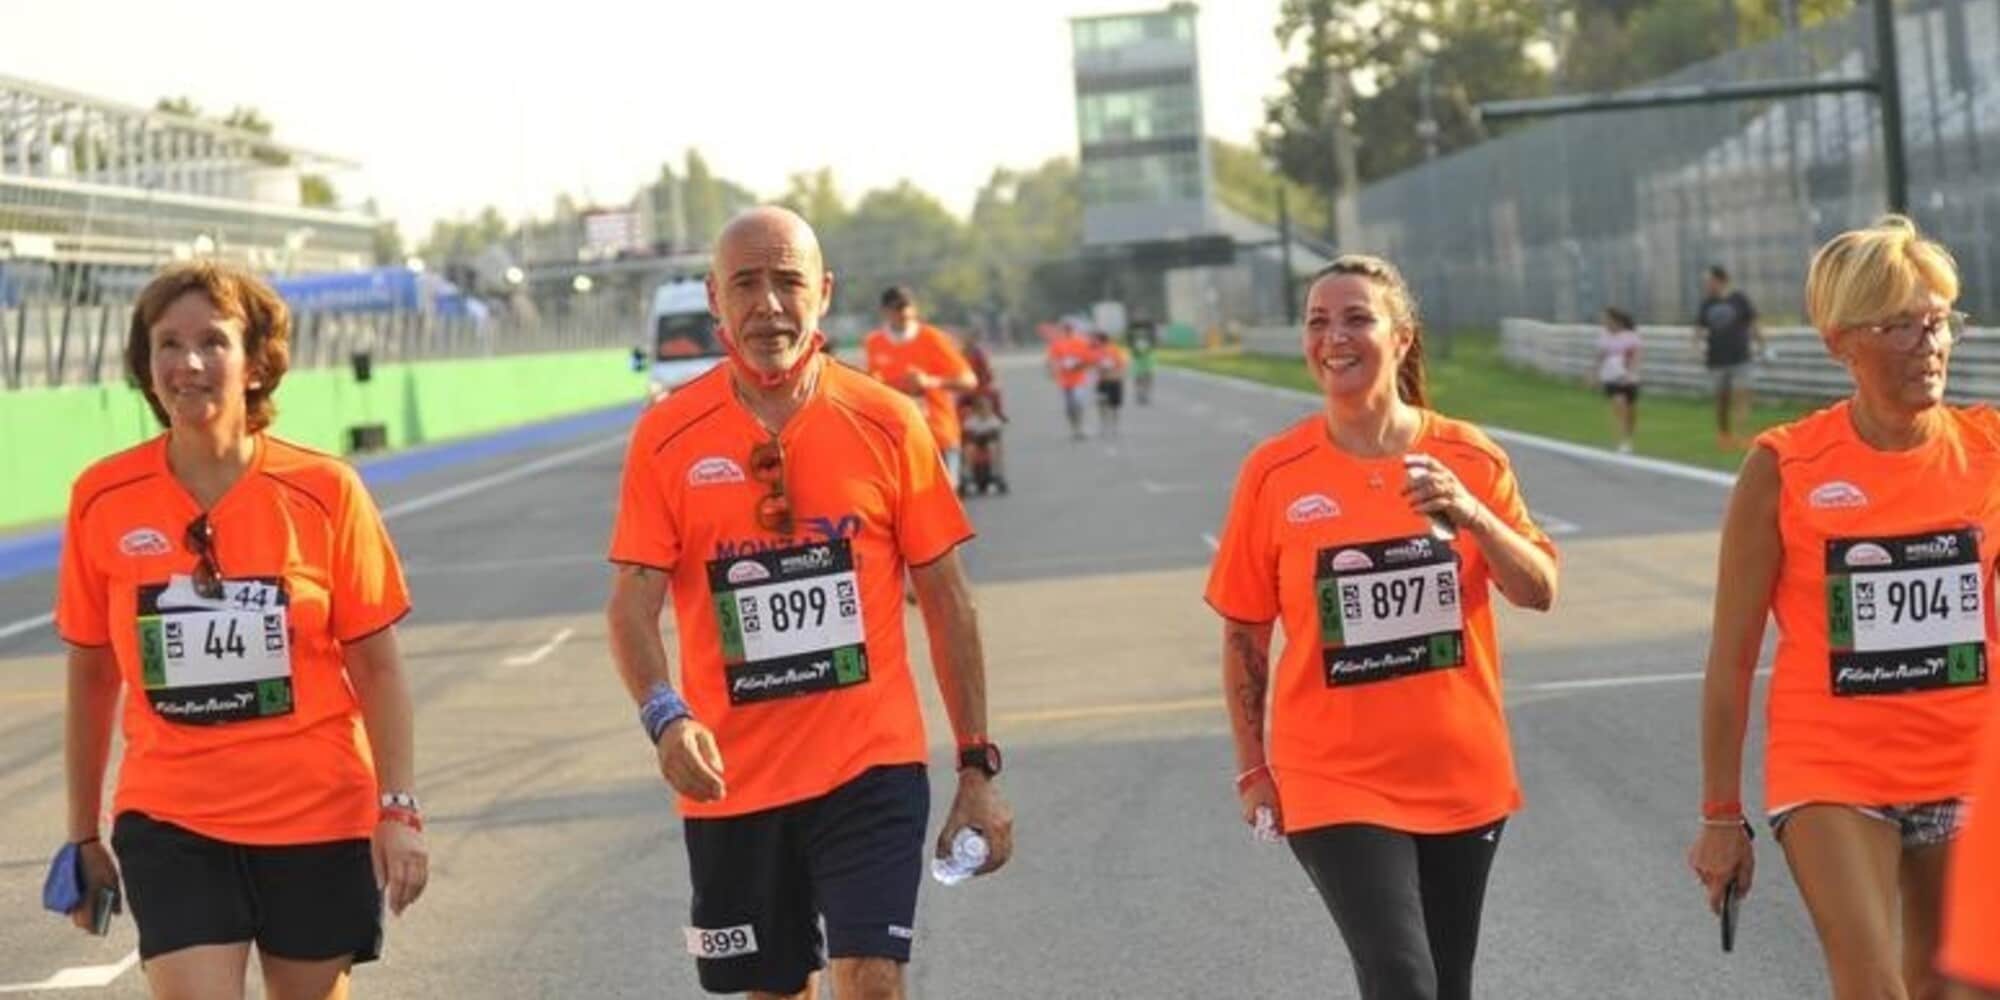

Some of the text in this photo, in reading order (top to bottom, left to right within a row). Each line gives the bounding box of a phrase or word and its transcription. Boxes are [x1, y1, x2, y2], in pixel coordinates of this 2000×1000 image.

[235, 587, 267, 606] 44
[769, 587, 826, 632] 899
[1371, 577, 1425, 620] 897
[1888, 577, 1949, 625] 904
[204, 619, 245, 659] 44
[700, 929, 748, 952] 899
